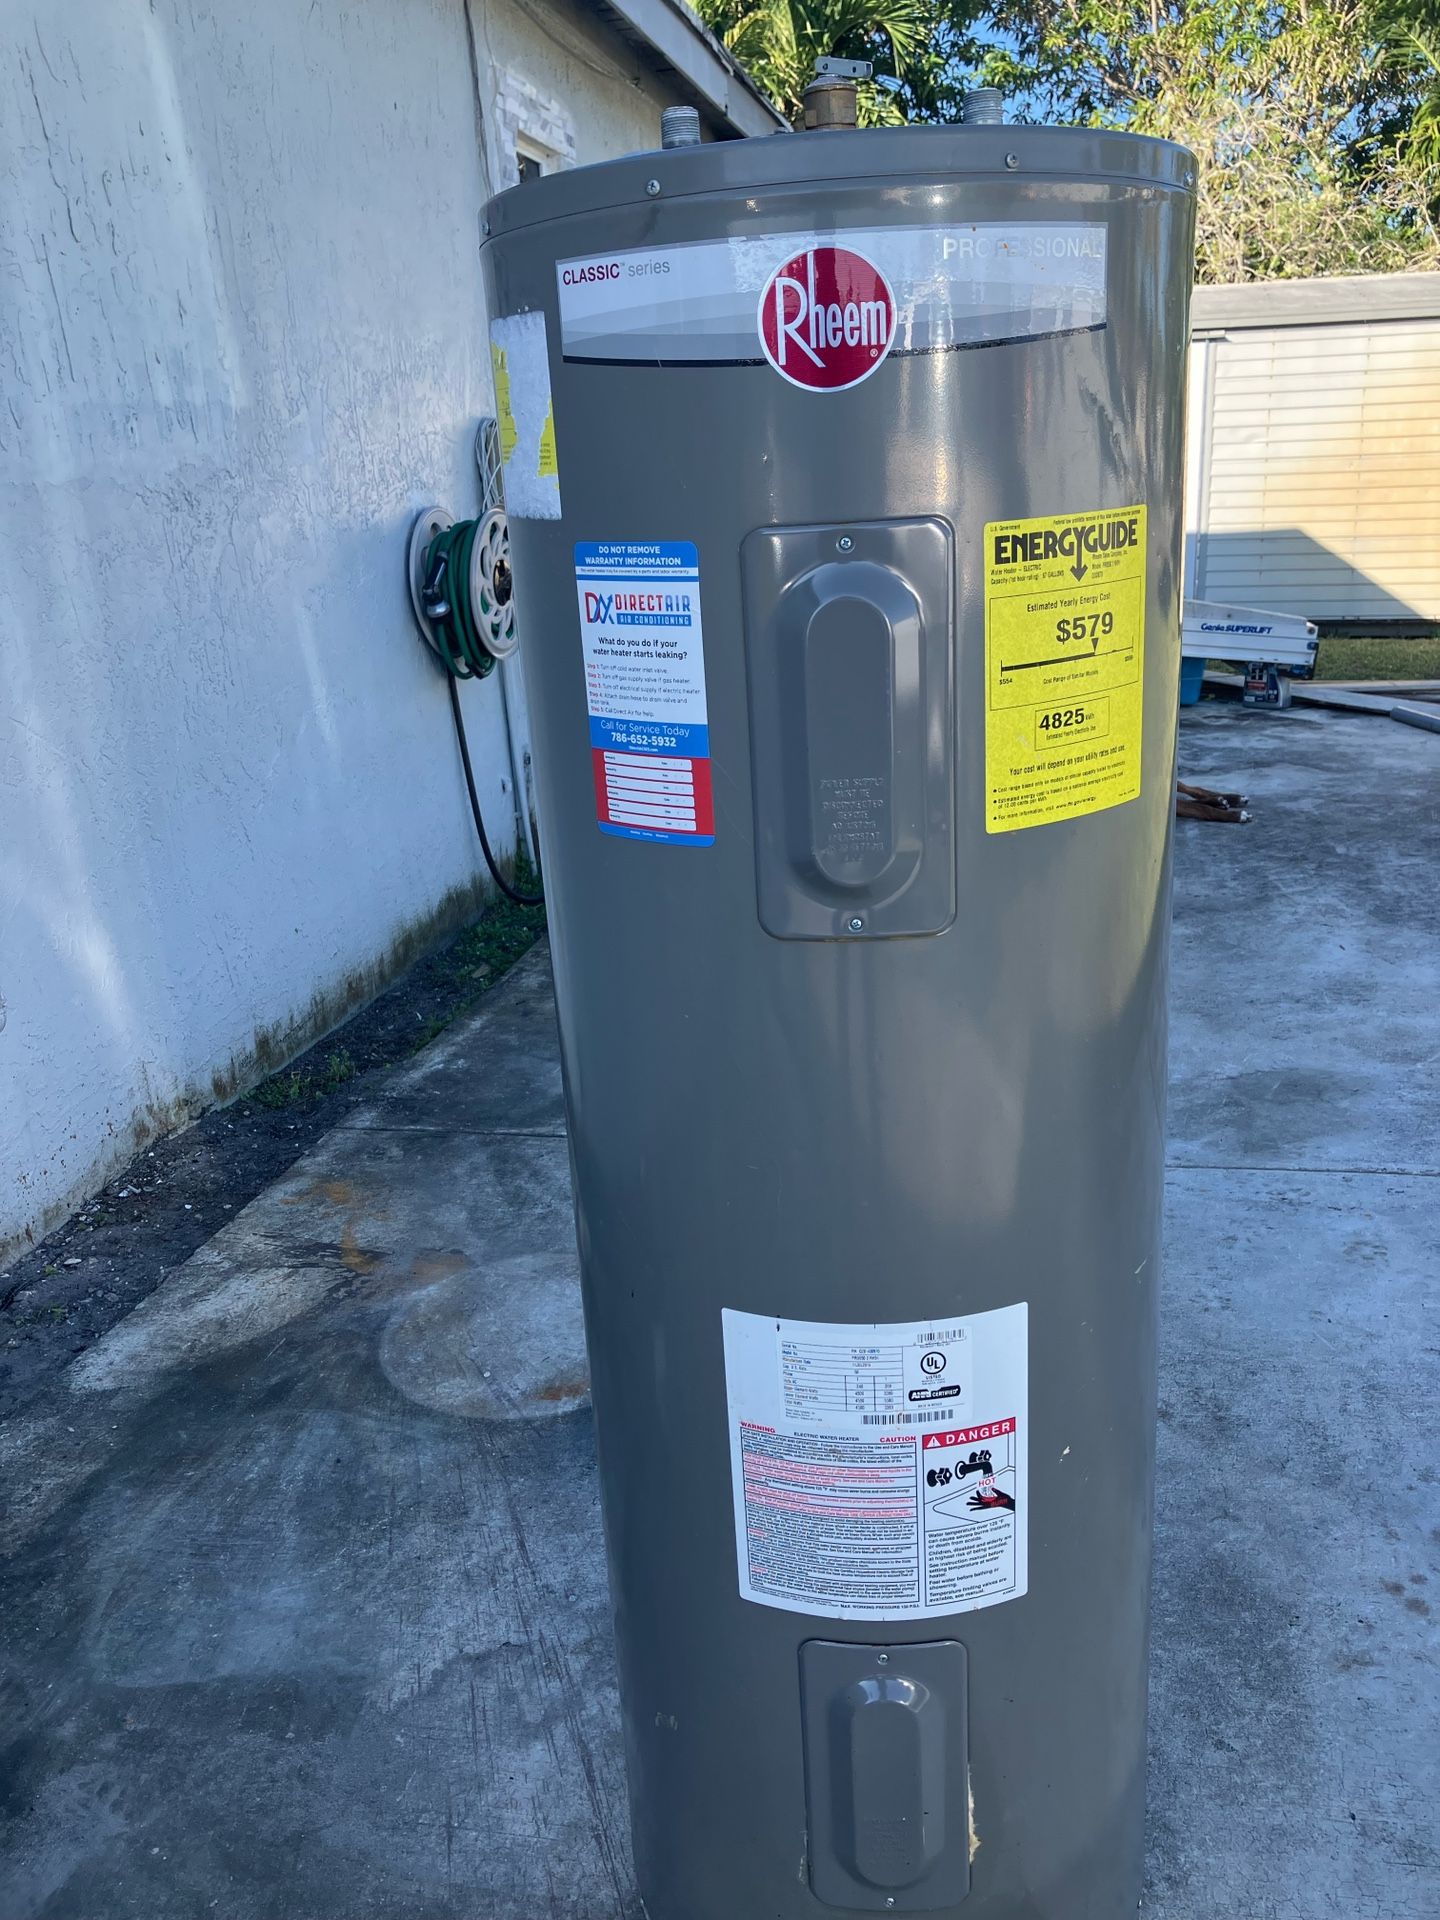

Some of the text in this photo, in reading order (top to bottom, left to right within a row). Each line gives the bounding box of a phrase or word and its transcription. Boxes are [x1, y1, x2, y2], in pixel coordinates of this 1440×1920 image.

[628, 260, 671, 277] series
[775, 251, 887, 368] Rheem
[599, 546, 609, 554] DO
[628, 546, 660, 554] REMOVE
[585, 557, 681, 566] WARRANTY INFORMATION
[1027, 592, 1110, 612] Estimated Yearly Energy Cost
[620, 615, 689, 625] AIR CONDITIONING
[1056, 611, 1113, 645] $579
[598, 637, 615, 645] What
[616, 638, 625, 646] do
[642, 639, 651, 647] do
[660, 640, 678, 649] your
[610, 648, 631, 657] heater
[633, 650, 653, 658] starts
[655, 650, 687, 660] leaking?
[1038, 708, 1084, 731] 4825
[601, 720, 690, 738] Call for Service Today
[611, 732, 676, 747] 786-652-5932
[1024, 765, 1035, 774] cost
[1036, 762, 1046, 771] will
[1074, 755, 1084, 765] your
[927, 1356, 940, 1369] UL
[740, 1422, 776, 1433] WARNING
[946, 1422, 1010, 1444] DANGER
[978, 1477, 996, 1487] HOT
[945, 1527, 976, 1536] temperature
